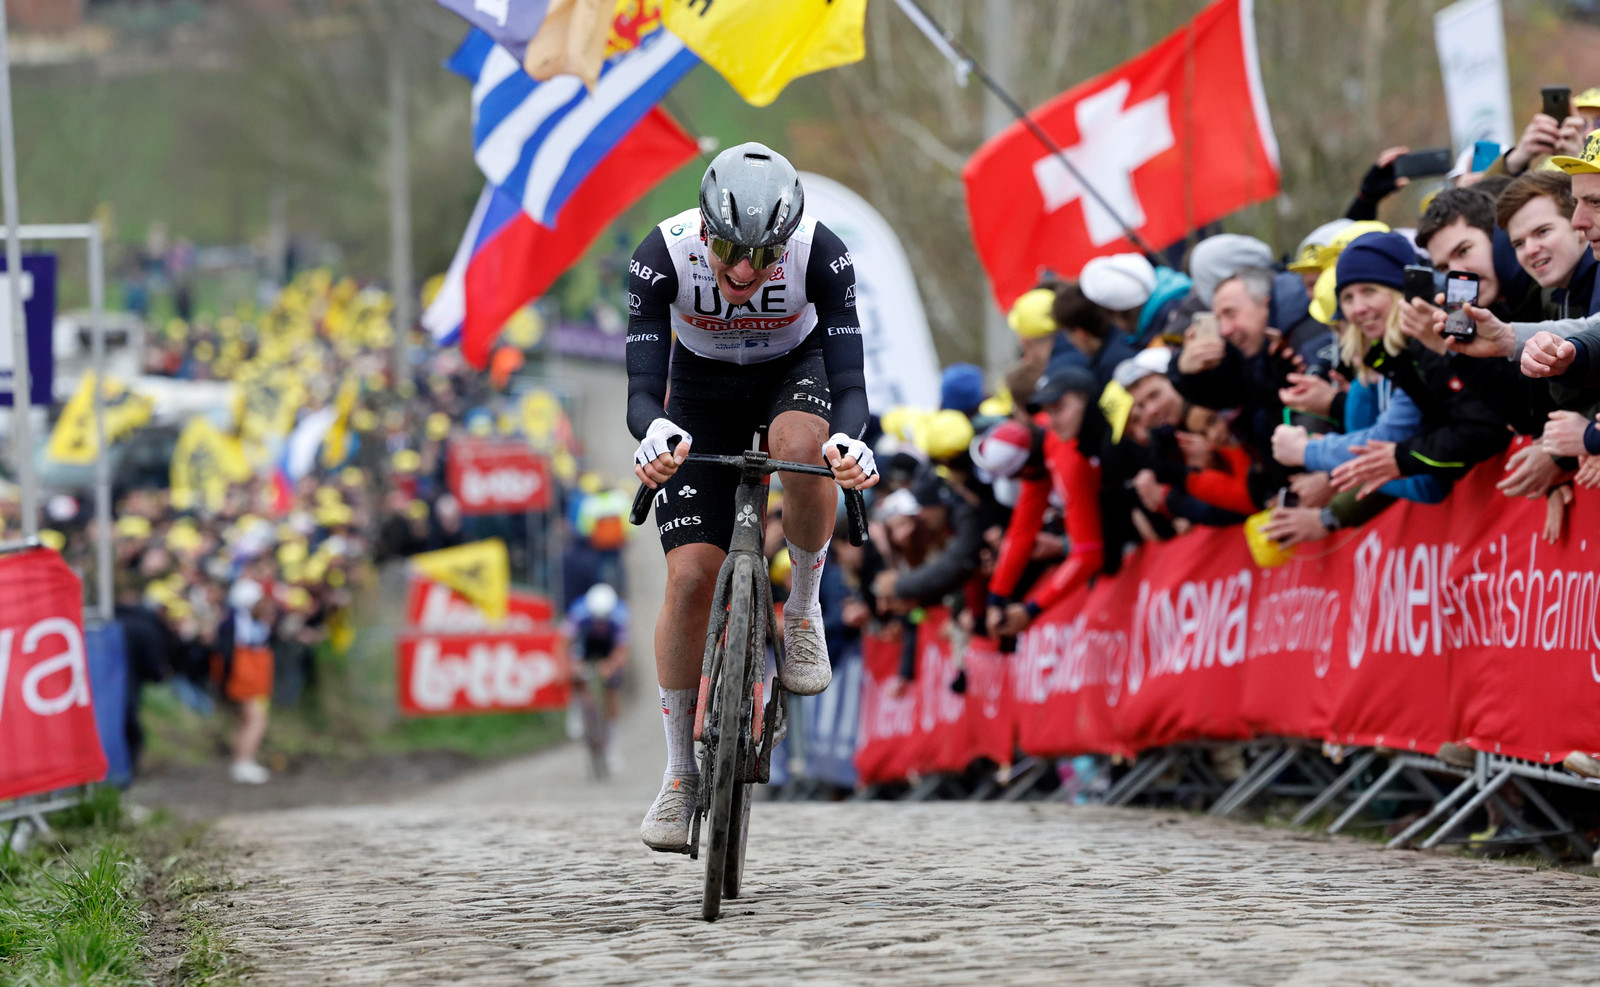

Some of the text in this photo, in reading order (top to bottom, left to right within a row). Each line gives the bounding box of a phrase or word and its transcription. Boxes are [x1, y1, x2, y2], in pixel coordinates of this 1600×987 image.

[691, 318, 791, 331] Emirates
[827, 325, 862, 336] Emira
[411, 640, 558, 710] lotto
